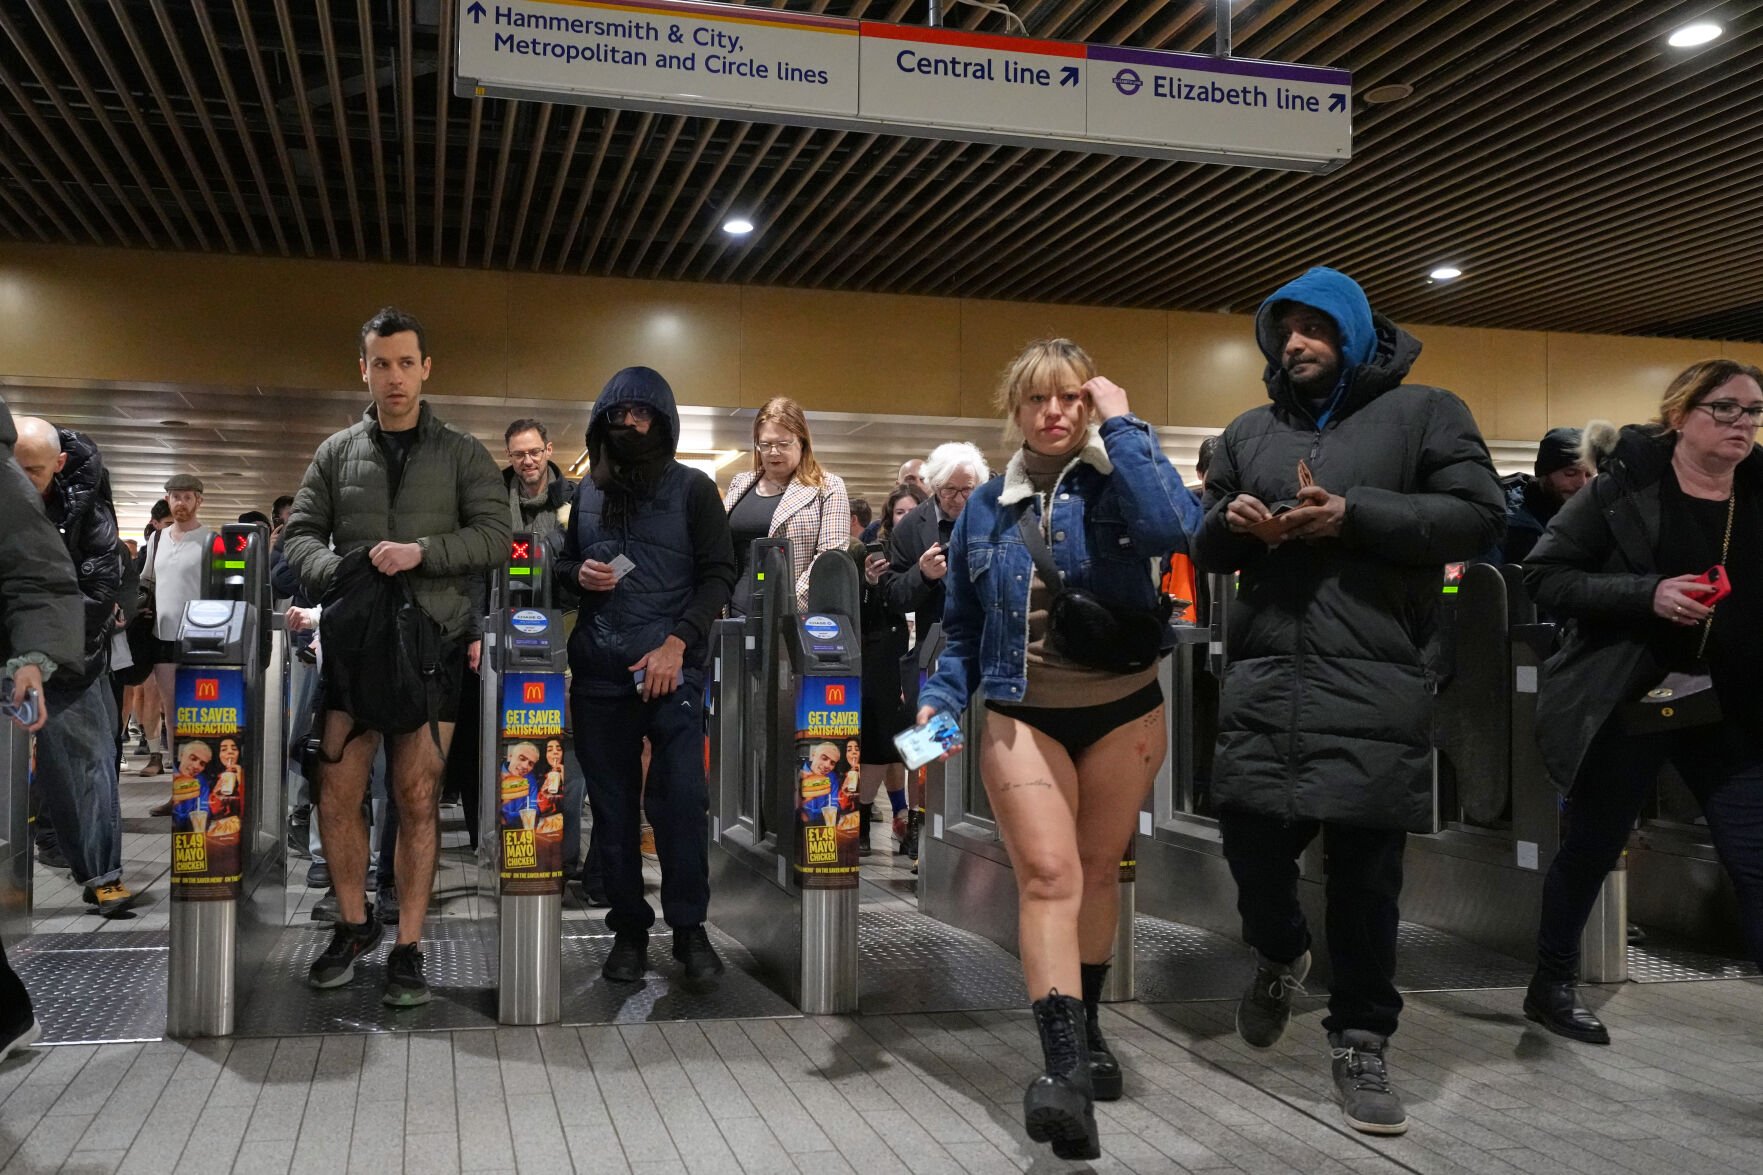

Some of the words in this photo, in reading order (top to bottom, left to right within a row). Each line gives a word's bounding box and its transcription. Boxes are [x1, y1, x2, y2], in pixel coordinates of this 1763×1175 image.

[495, 6, 659, 42] Hammersmith
[667, 24, 684, 44] &
[692, 27, 744, 54] City,
[494, 33, 647, 67] Metropolitan
[655, 53, 696, 72] and
[704, 55, 769, 79] Circle
[777, 61, 829, 85] lines
[896, 50, 995, 81] Central
[1004, 60, 1051, 87] line
[1153, 76, 1267, 108] Elizabeth
[1276, 87, 1320, 113] line
[178, 707, 198, 722] GET
[200, 707, 237, 722] SAVER
[506, 710, 526, 724] GET
[528, 710, 561, 724] SAVER
[808, 711, 828, 725] GET
[830, 711, 859, 725] SAVER
[177, 722, 238, 734] SATISFACTION
[506, 724, 561, 735] SATISFACTION
[808, 724, 859, 736] SATISFACTION
[175, 833, 204, 849] £1.49
[506, 830, 533, 845] £1.49
[808, 827, 835, 841] £1.49
[507, 844, 534, 857] MAYO
[809, 840, 835, 853] MAYO
[176, 848, 205, 861] MAYO
[507, 857, 535, 866] CHICKEN
[810, 852, 836, 862] CHICKEN
[177, 861, 205, 871] CHICKEN
